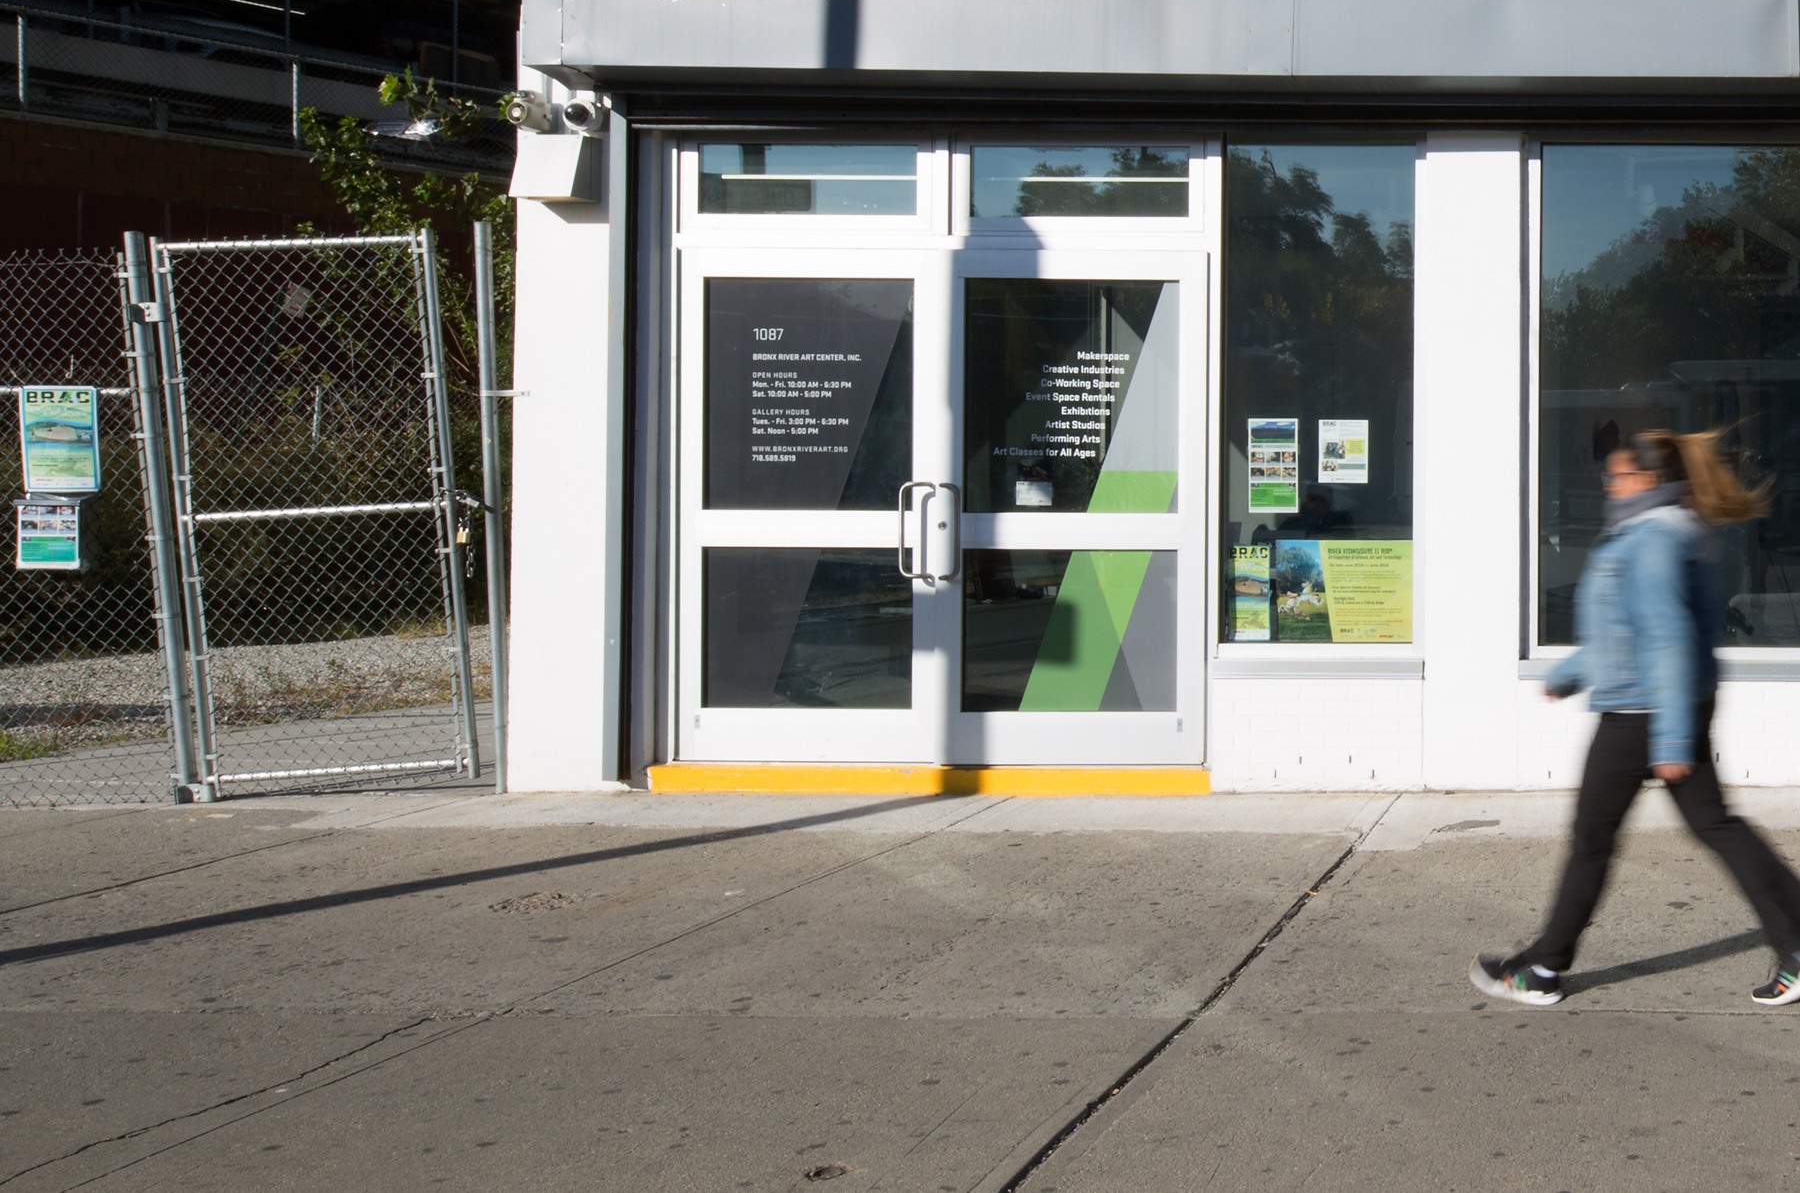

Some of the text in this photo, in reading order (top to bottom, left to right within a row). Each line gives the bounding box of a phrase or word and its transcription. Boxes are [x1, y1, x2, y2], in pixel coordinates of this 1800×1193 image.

[753, 328, 784, 340] 1087
[1077, 351, 1130, 361] Makerspace
[1042, 365, 1125, 374] Creative Industries
[1041, 379, 1120, 389] Co-Working Space
[26, 391, 91, 403] BRAC
[1026, 393, 1115, 403] Event Space Rentals
[1061, 407, 1110, 416] Exhibitions
[1045, 421, 1106, 429] Artist Studios
[1031, 434, 1100, 445] Performing Arts
[1009, 448, 1043, 456] Classes
[1046, 448, 1058, 456] for
[1074, 449, 1096, 459] Ages
[1229, 547, 1268, 558] BRAC
